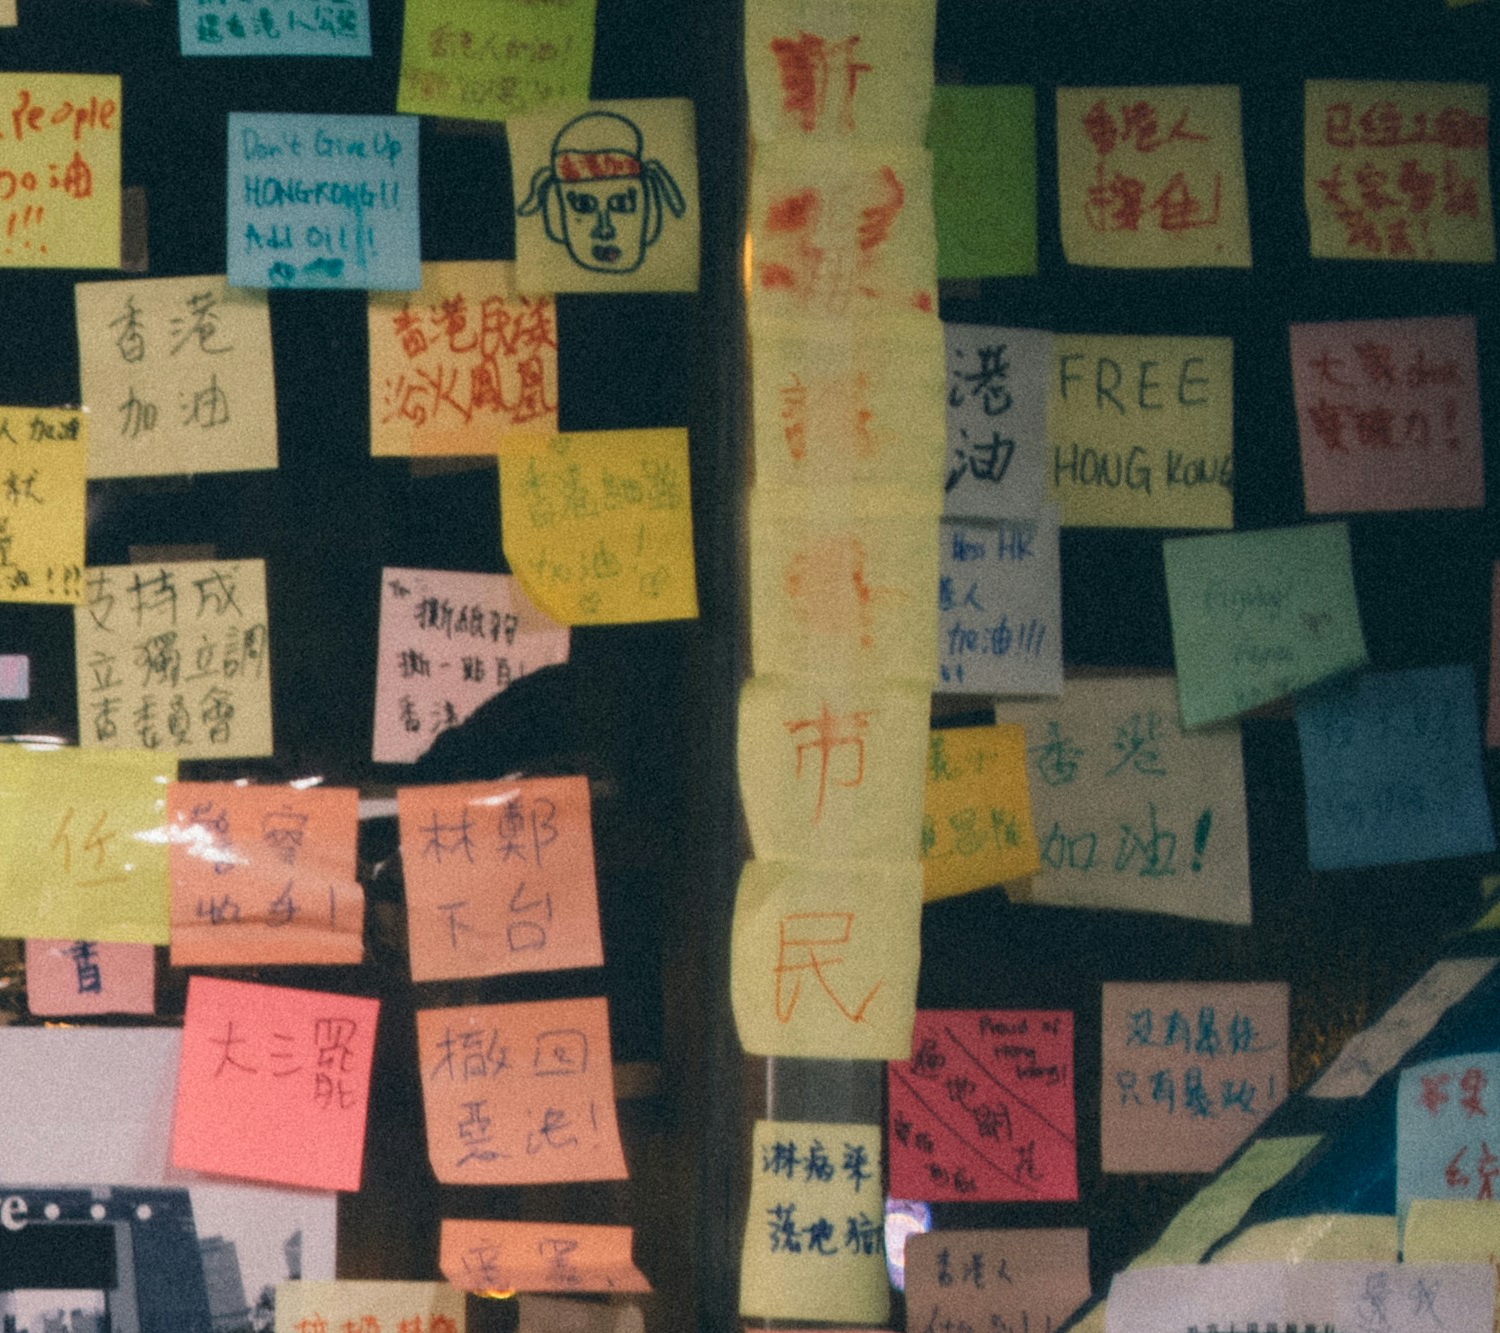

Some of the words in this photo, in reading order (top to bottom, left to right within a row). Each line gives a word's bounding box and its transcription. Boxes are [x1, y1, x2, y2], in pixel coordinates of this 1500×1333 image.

[107, 291, 235, 365] 香港
[117, 374, 231, 441] 加油
[1060, 354, 1210, 408] FREE
[1053, 445, 1156, 493] HONG
[1029, 720, 1168, 786] 香港
[1041, 808, 1212, 877] 加油!
[205, 1013, 358, 1113] 大三罷
